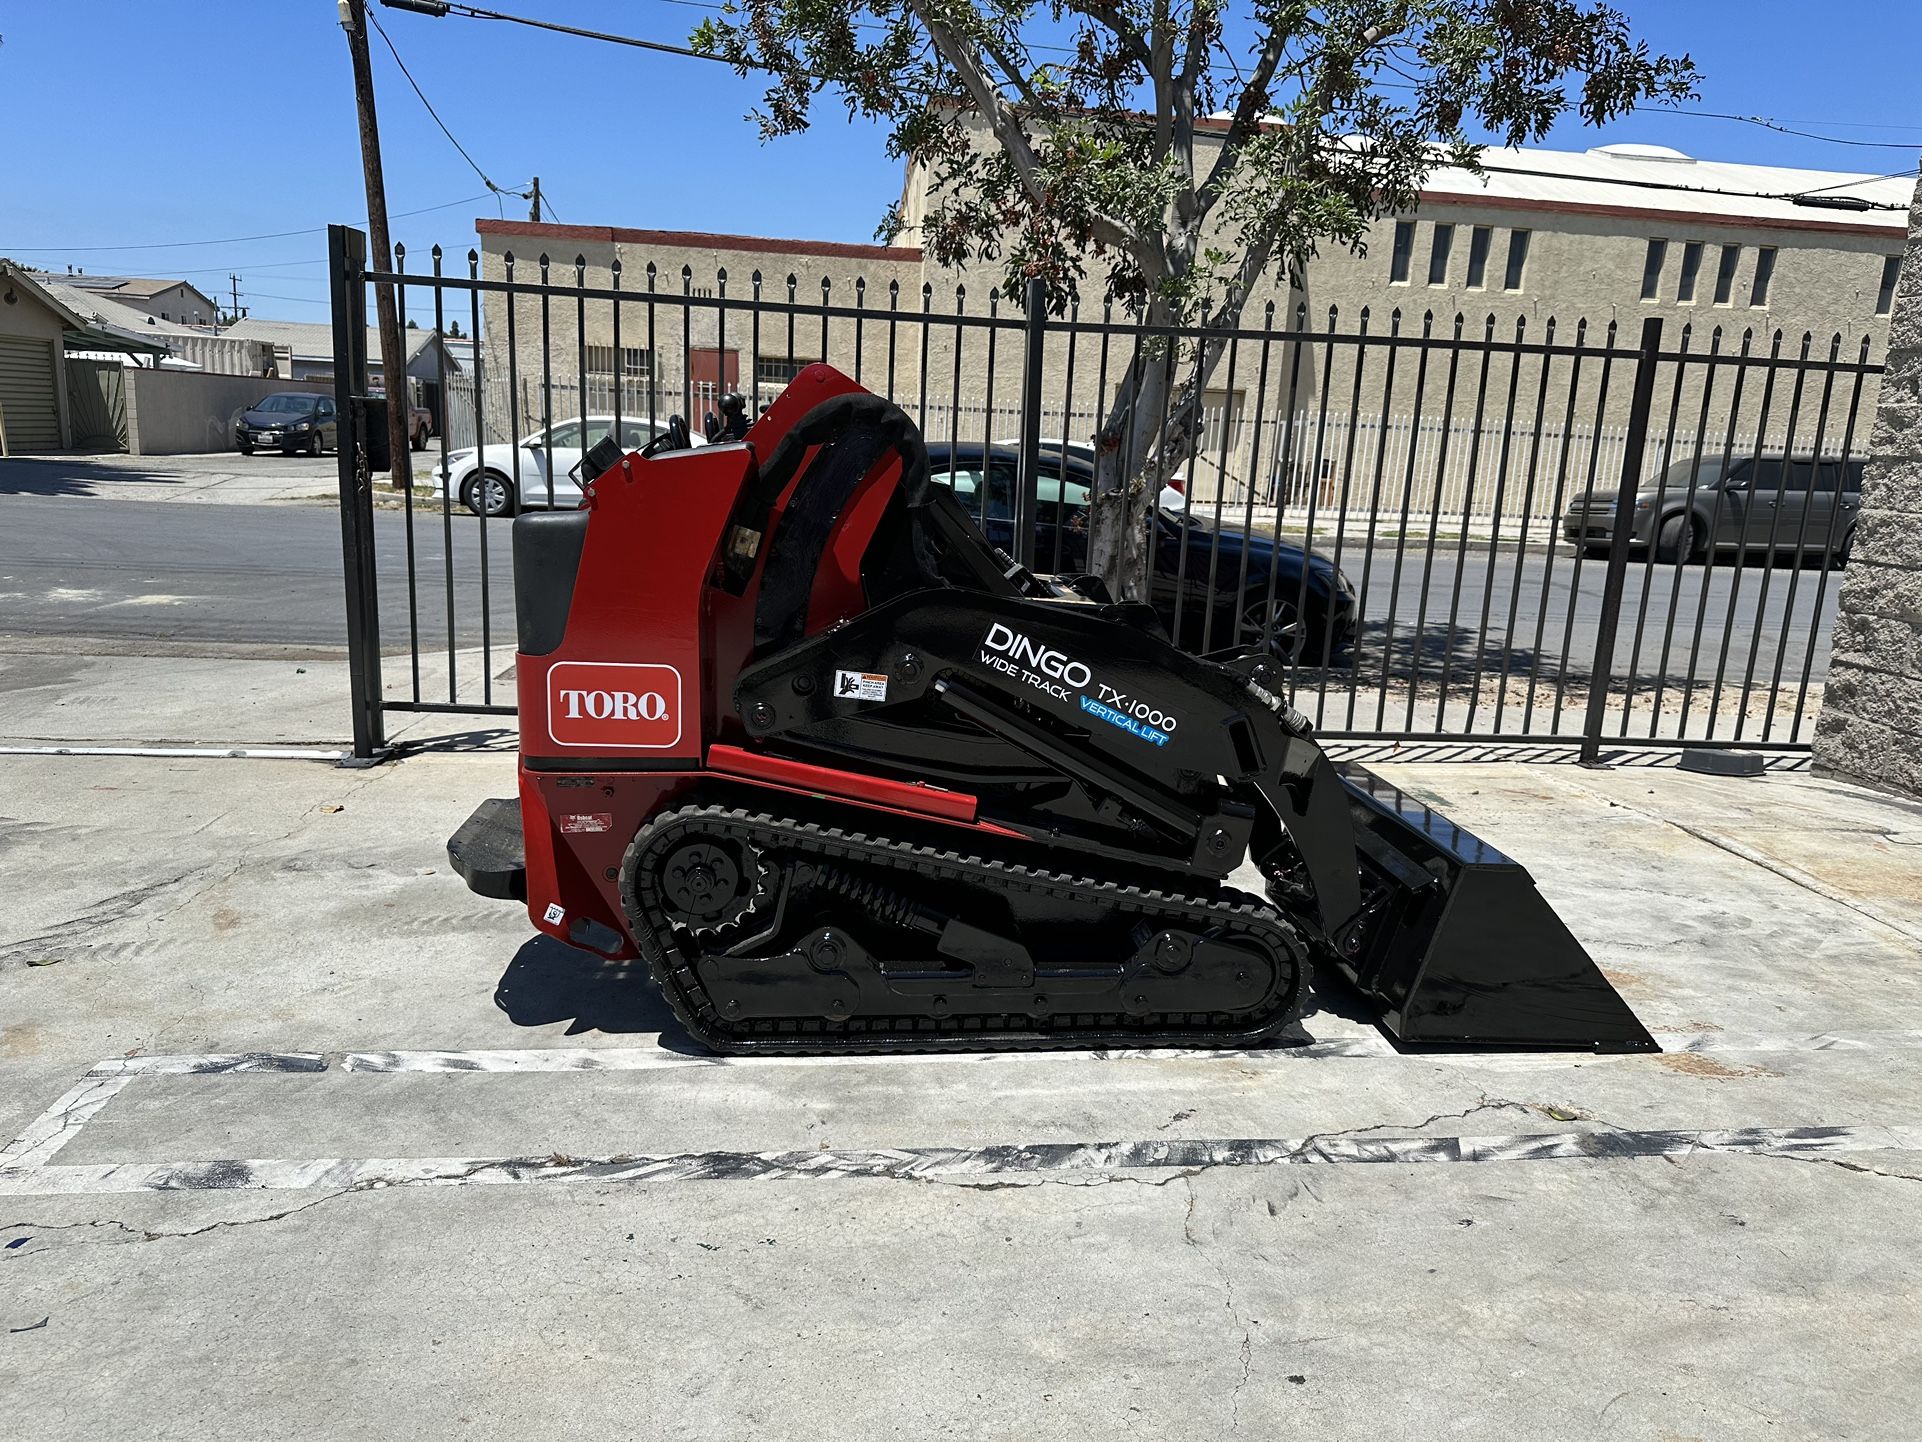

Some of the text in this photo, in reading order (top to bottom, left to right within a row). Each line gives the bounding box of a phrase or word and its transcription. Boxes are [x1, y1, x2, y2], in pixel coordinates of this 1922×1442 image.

[981, 650, 1072, 702] WIDE TRACK
[984, 622, 1092, 688] DINGO
[1080, 697, 1168, 746] VERTICAL LIFT
